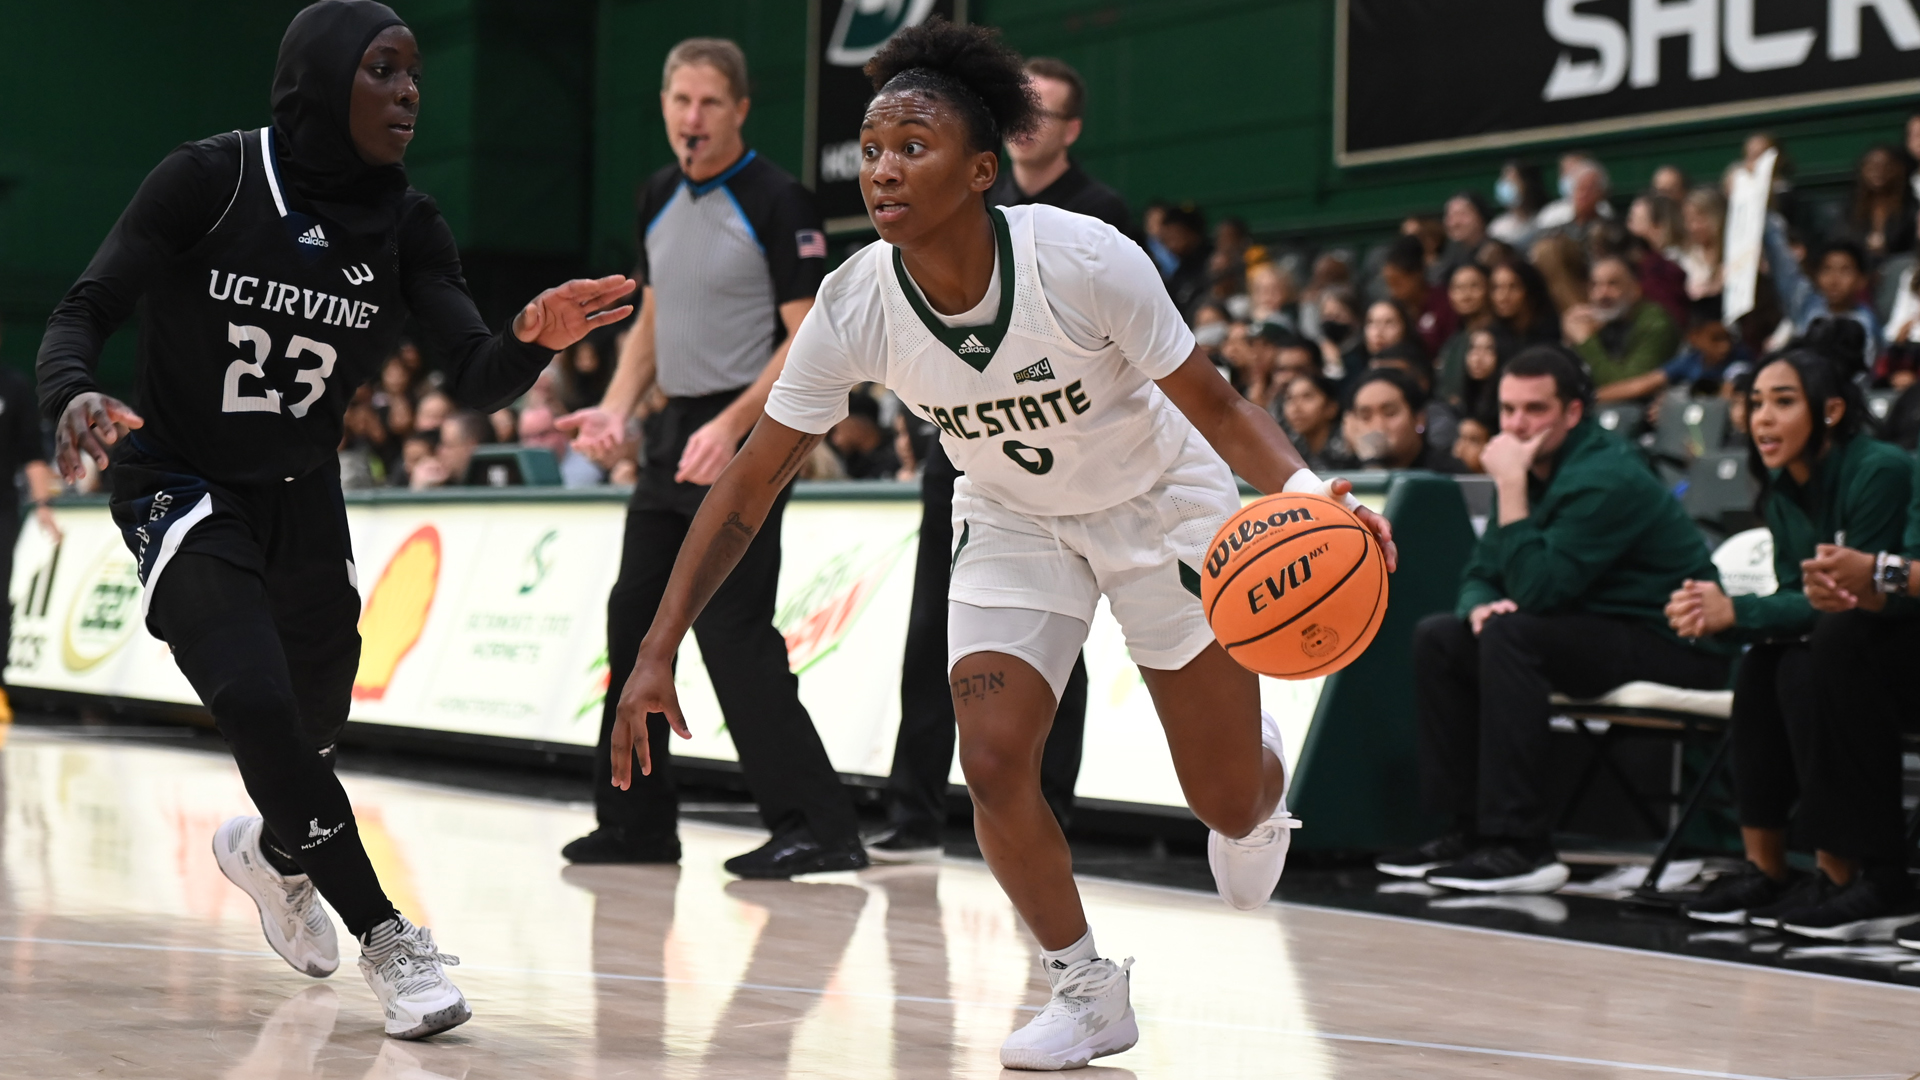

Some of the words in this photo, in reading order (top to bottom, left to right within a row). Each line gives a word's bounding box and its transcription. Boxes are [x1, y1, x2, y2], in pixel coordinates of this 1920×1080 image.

[298, 235, 329, 248] adidas
[208, 268, 260, 306] UC
[260, 280, 380, 329] IRVINE
[221, 320, 338, 419] 23
[958, 345, 991, 355] adidas
[975, 378, 1092, 438] STATE
[1002, 439, 1054, 476] 0
[1205, 507, 1314, 580] Wilson
[1247, 554, 1313, 615] EVO
[1308, 541, 1330, 561] NXT
[301, 821, 343, 850] MUELLER
